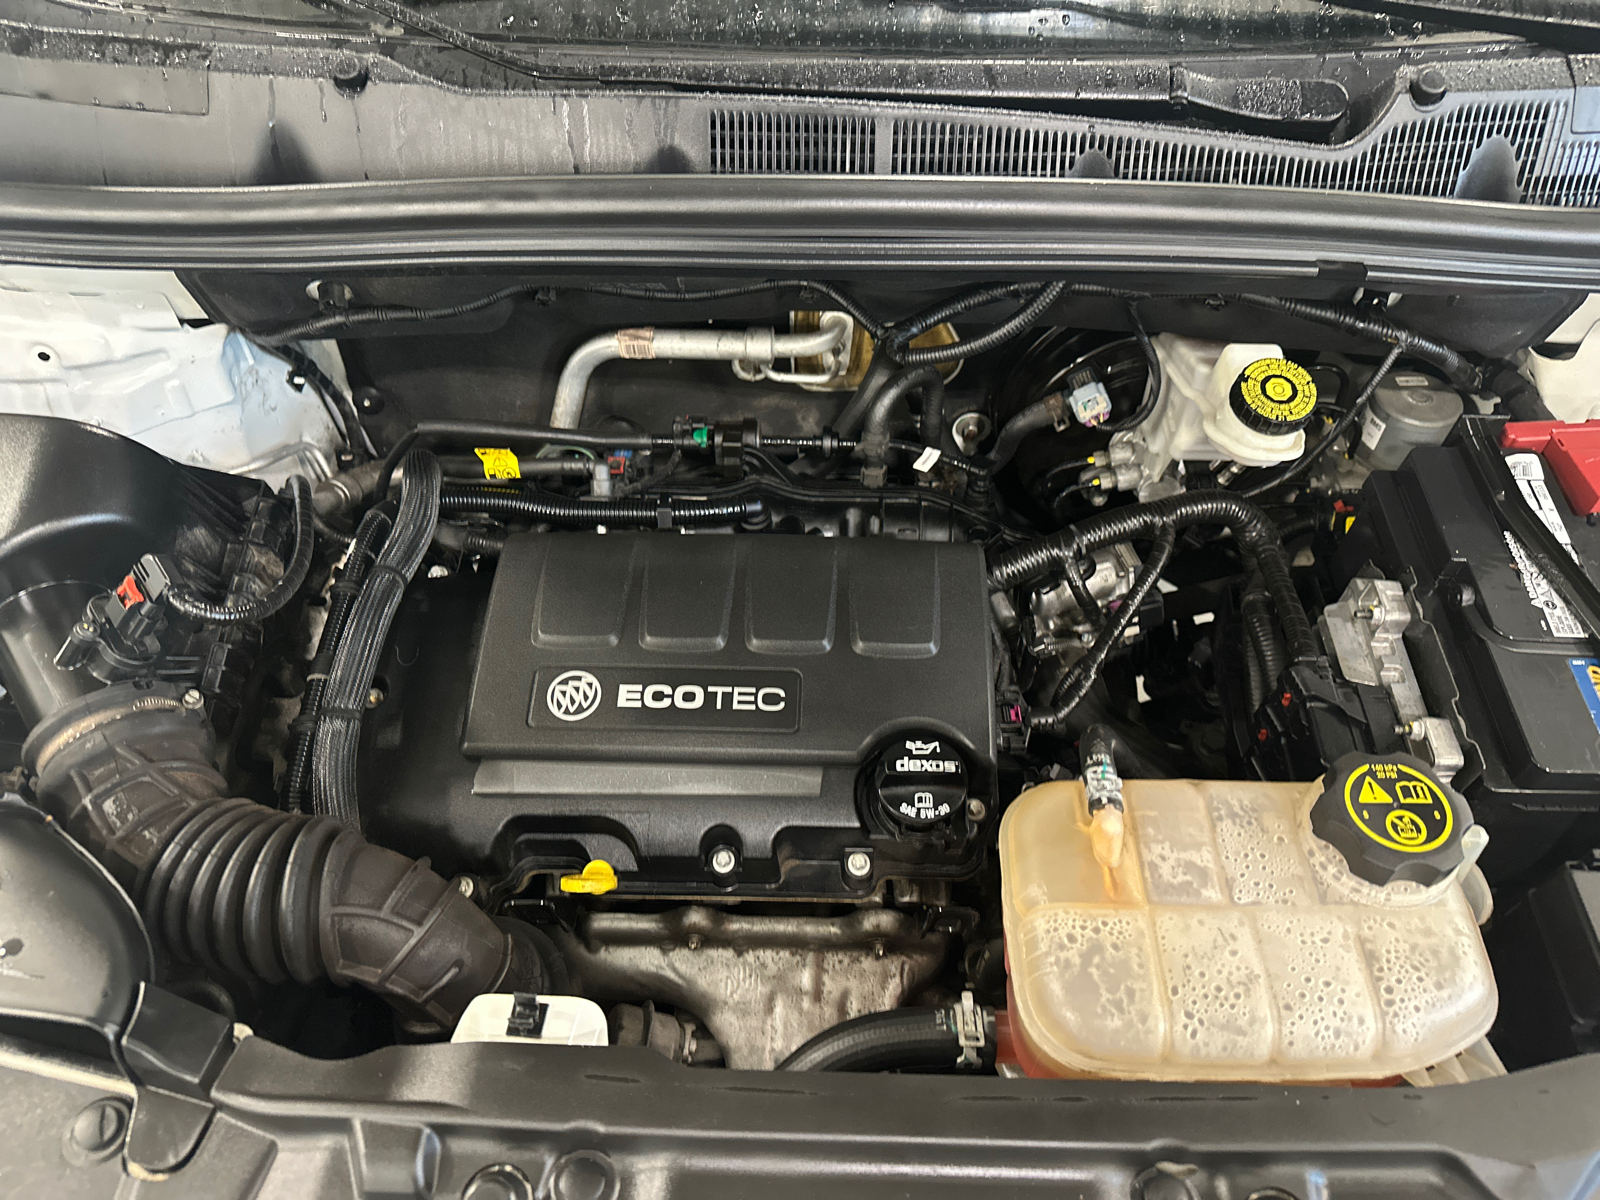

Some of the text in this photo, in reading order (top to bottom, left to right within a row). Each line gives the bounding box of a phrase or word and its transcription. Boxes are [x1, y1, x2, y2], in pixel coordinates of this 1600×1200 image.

[616, 683, 786, 712] ECOTEC
[896, 756, 956, 772] dexos
[899, 802, 917, 818] SAE
